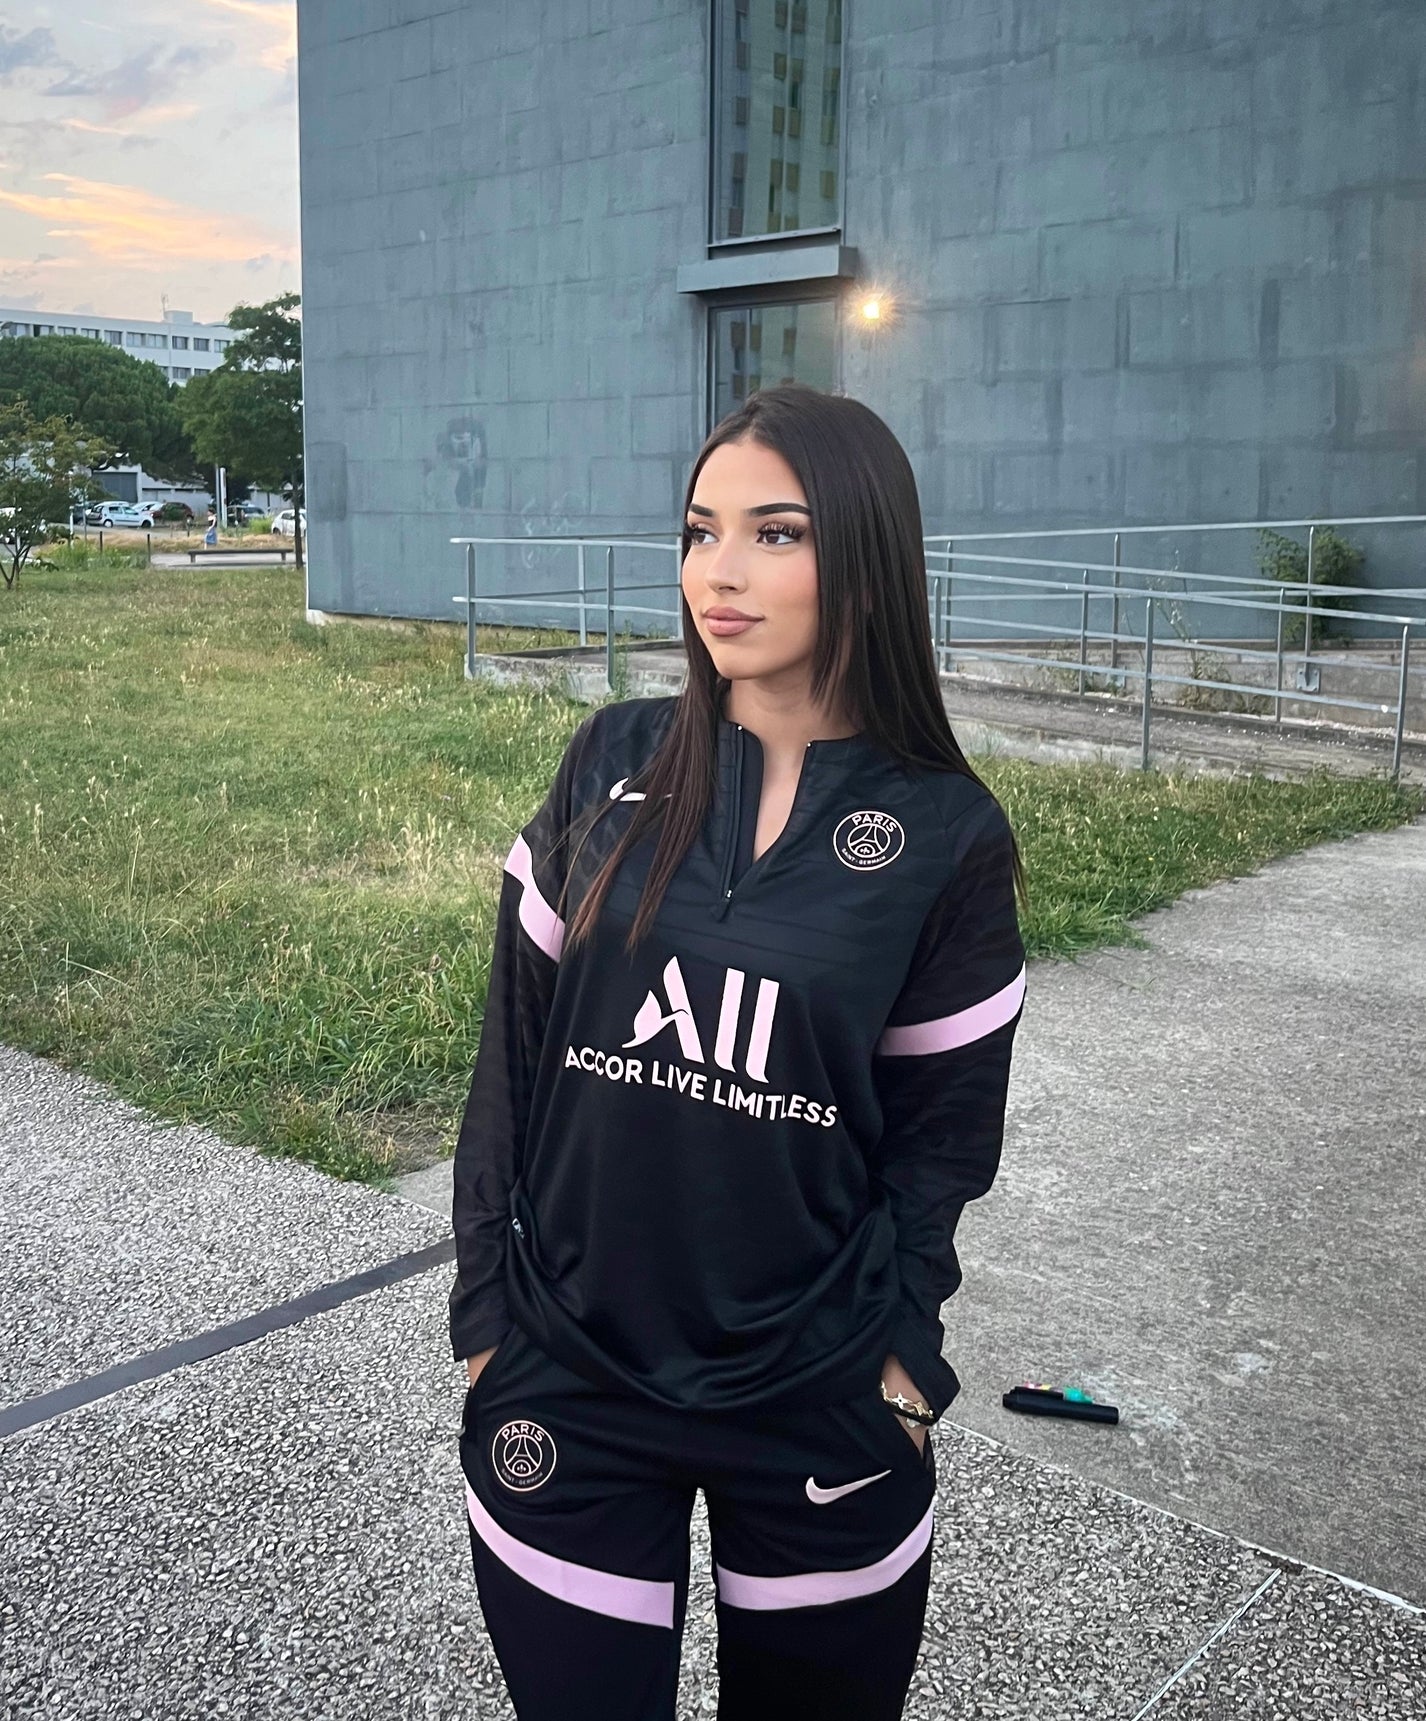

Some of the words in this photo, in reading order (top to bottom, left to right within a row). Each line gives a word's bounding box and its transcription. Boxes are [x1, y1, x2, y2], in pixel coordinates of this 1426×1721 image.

[852, 813, 897, 833] PARIS
[564, 1045, 643, 1084] ACCOR
[651, 1060, 707, 1101] LIVE
[712, 1078, 838, 1128] LIMITLESS
[501, 1423, 545, 1442] PARIS
